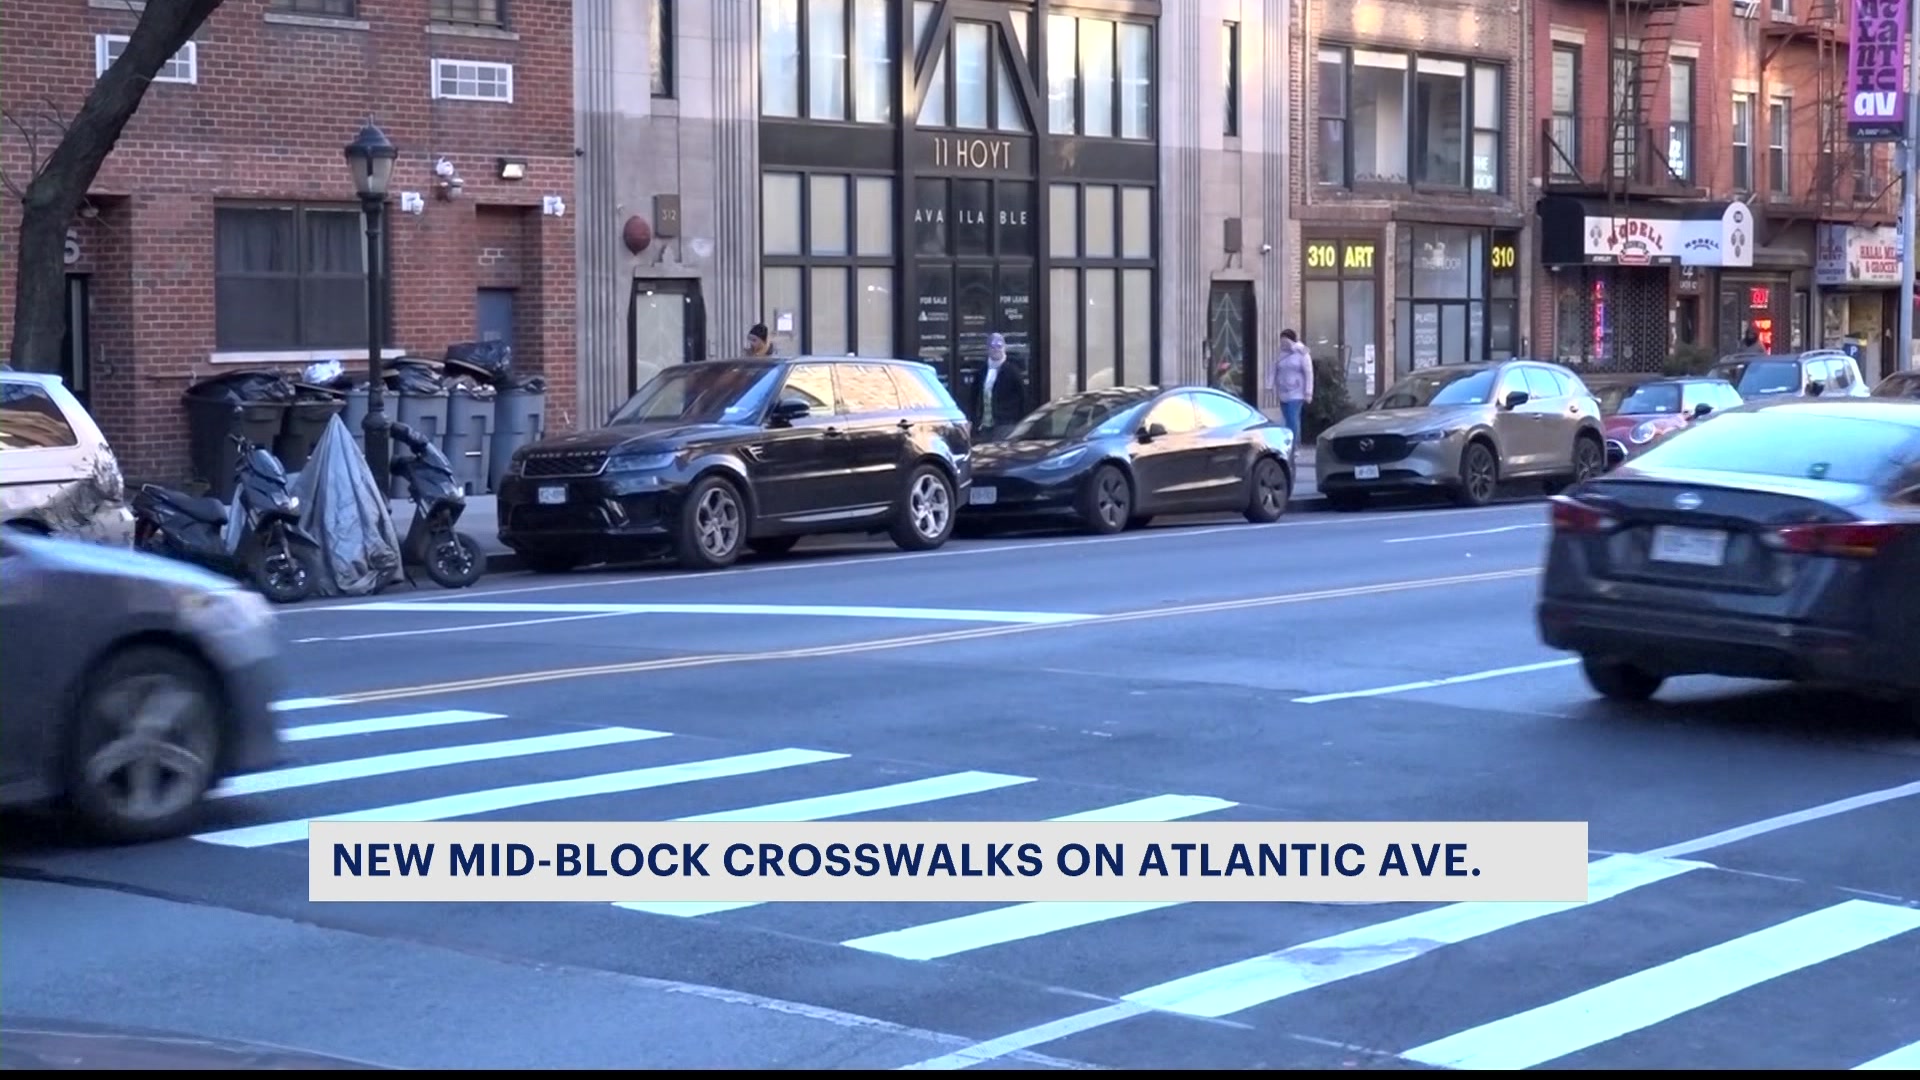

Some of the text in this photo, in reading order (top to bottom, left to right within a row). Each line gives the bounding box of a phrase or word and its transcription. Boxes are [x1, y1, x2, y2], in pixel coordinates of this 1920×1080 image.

[934, 137, 1011, 169] 11 HOYT
[1607, 220, 1664, 251] MODELL
[1308, 245, 1374, 268] 310 ART
[1492, 247, 1514, 268] 310
